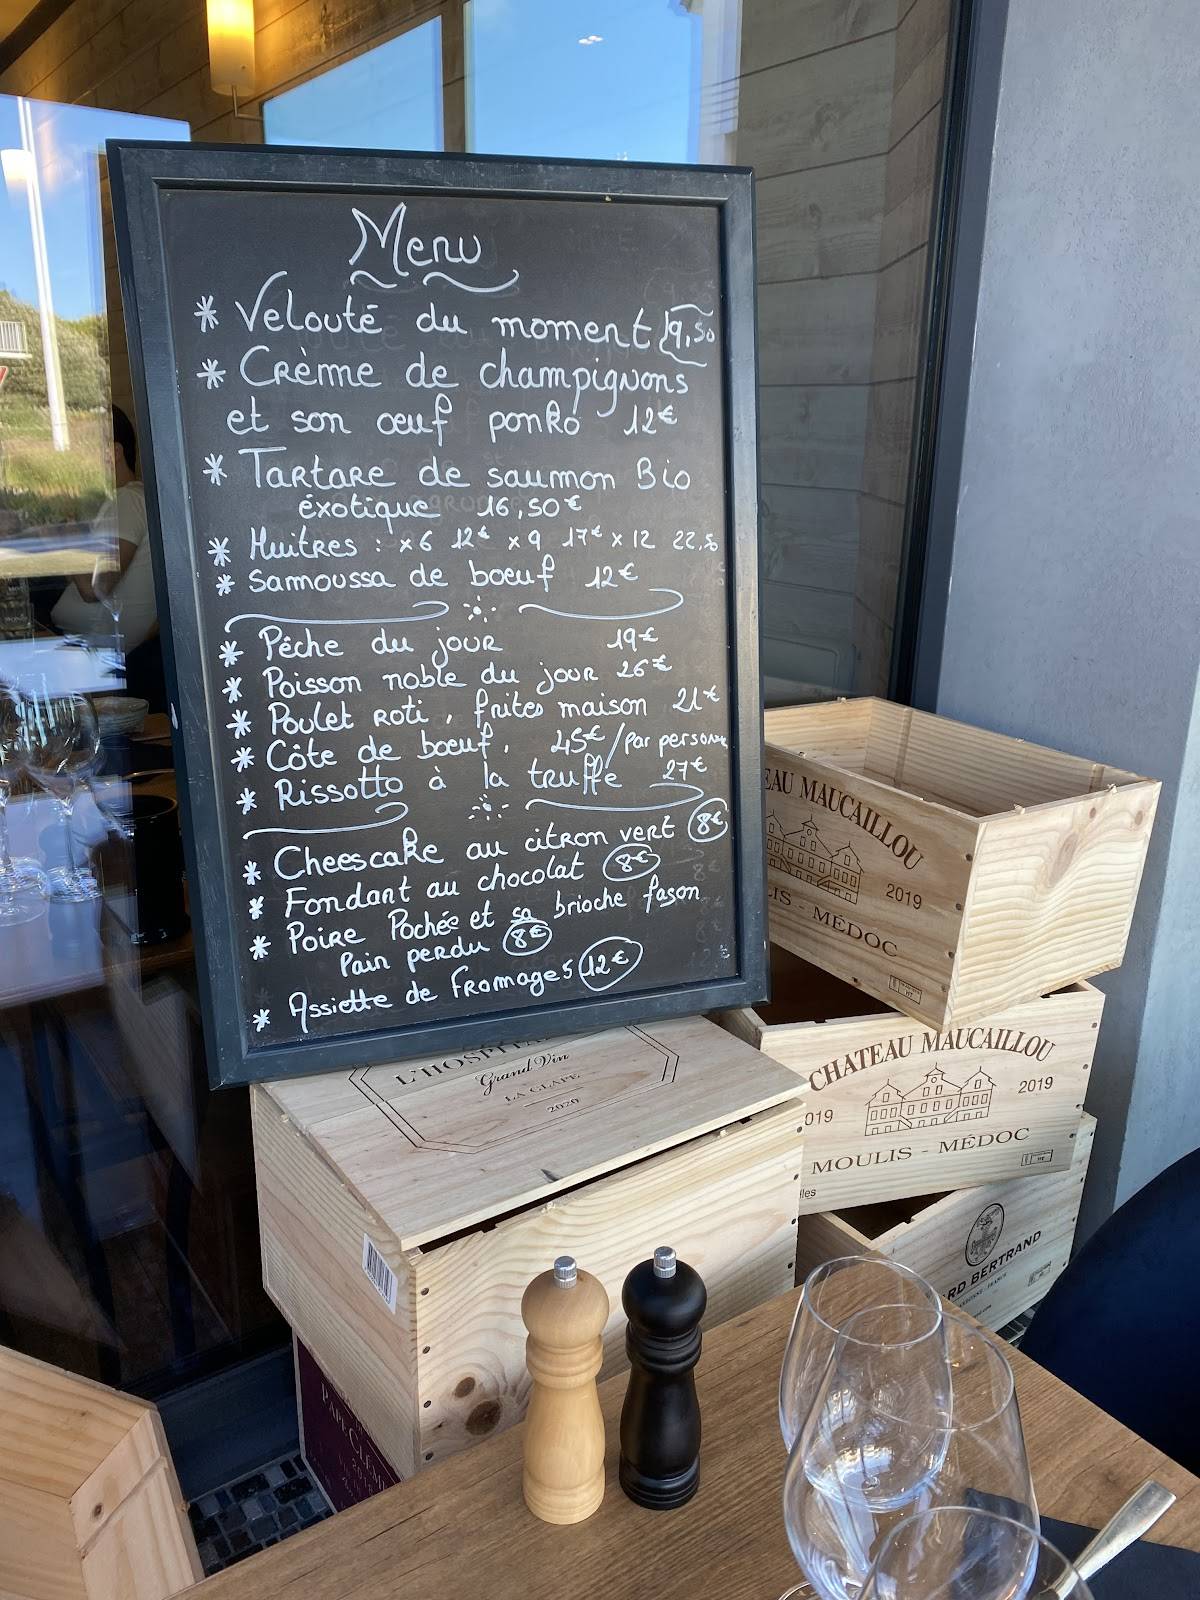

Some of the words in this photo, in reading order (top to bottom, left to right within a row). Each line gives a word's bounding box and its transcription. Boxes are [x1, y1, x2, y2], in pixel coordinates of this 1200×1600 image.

[349, 202, 481, 276] Menu
[235, 271, 382, 334] Velouté
[416, 302, 467, 334] du
[491, 308, 651, 349] moment
[240, 345, 382, 387] Crème
[406, 351, 459, 388] de
[480, 347, 688, 417] champignons
[226, 396, 269, 434] et
[291, 410, 352, 433] son
[624, 404, 677, 435] 12€
[238, 446, 396, 489] Tartare
[419, 456, 470, 487] de
[487, 467, 615, 490] saumon
[637, 457, 690, 490] Bio
[477, 495, 582, 519] 16,50€
[250, 525, 358, 560] Huitres
[451, 525, 491, 549] 12€
[562, 524, 603, 547] 17€
[249, 568, 397, 592] Samoussa
[409, 563, 448, 587] de
[584, 563, 638, 589] 12€
[258, 625, 344, 661] Pêche
[371, 628, 414, 654] du
[431, 627, 503, 669] jour
[607, 627, 658, 652] 19€
[262, 666, 362, 699] Poisson
[382, 664, 468, 691] noble
[480, 662, 520, 685] du
[536, 662, 599, 695] jour
[616, 655, 672, 679] 26€
[268, 701, 354, 735] Poulet
[474, 688, 544, 729] frites
[557, 693, 648, 717] maison
[672, 685, 720, 712] 21€
[266, 737, 338, 772] Côte
[358, 735, 401, 764] de
[274, 764, 404, 811] Rissotto
[428, 766, 447, 791] à
[483, 760, 510, 789] la
[527, 753, 623, 795] truffe
[662, 756, 708, 782] 27€
[273, 827, 445, 880] Cheescake
[466, 840, 508, 860] au
[524, 822, 608, 852] citron
[620, 815, 675, 842] vert
[697, 811, 724, 835] 8€
[799, 776, 924, 870] MAUCAILLOU
[284, 876, 412, 918] Fondant
[426, 880, 460, 898] au
[477, 851, 585, 892] chocolat
[615, 851, 649, 873] 8€
[886, 883, 922, 910] 2019
[286, 921, 366, 954] Poire
[388, 908, 459, 941] Pochée
[469, 900, 495, 930] et
[511, 906, 538, 922] sa
[554, 890, 628, 919] brioche
[812, 906, 898, 957] MÉDOC
[340, 952, 391, 977] Pain
[407, 935, 490, 973] perdu
[510, 926, 547, 948] 8€
[288, 988, 393, 1034] Assiette
[405, 980, 438, 1005] de
[583, 950, 629, 977] 12€
[474, 1058, 533, 1096] Grand
[533, 1053, 570, 1068] Vin
[808, 1035, 913, 1092] CHATEAU
[922, 1027, 1056, 1062] MAUCAILLOU
[1017, 1076, 1054, 1094] 2019
[804, 1109, 834, 1127] 019
[811, 1146, 913, 1175] MOULIS
[938, 1127, 1031, 1155] MÉDOC
[971, 1230, 1042, 1286] BERTRAND
